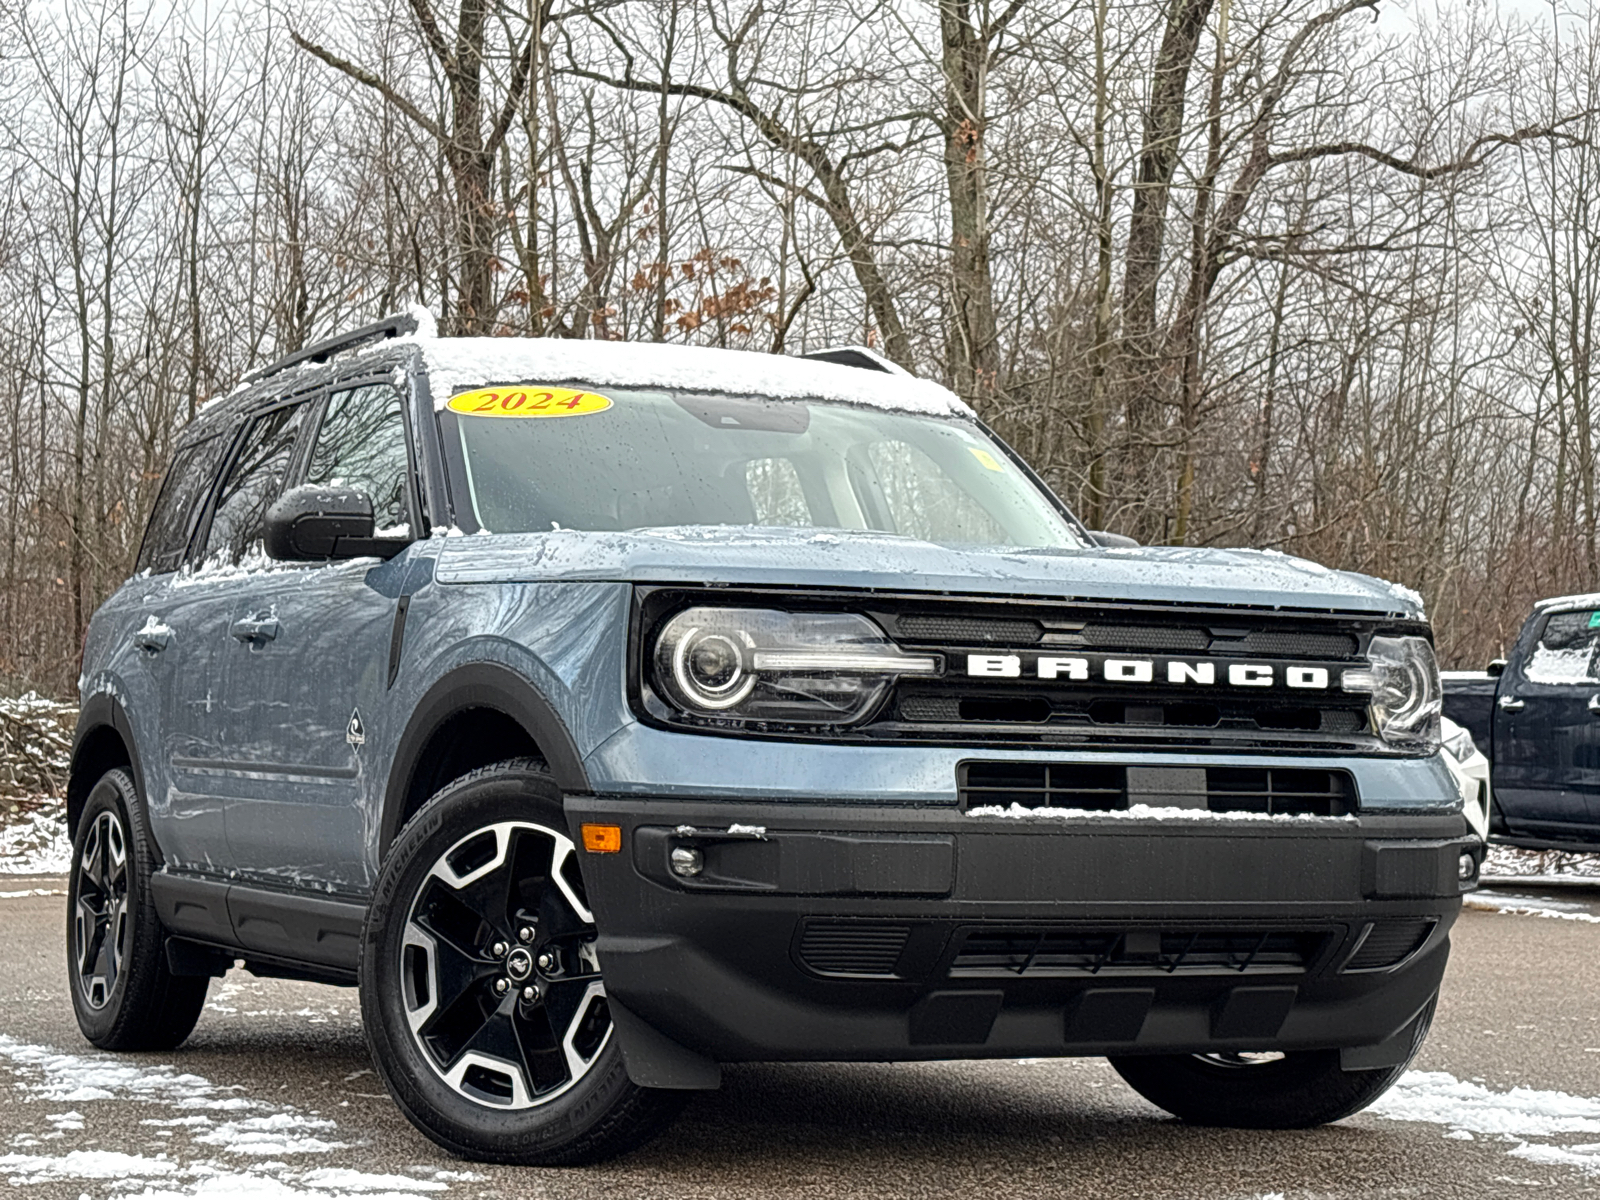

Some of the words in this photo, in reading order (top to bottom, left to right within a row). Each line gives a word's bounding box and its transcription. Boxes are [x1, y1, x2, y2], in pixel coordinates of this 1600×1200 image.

[472, 392, 585, 412] 2024
[967, 653, 1329, 689] BRONCO
[382, 813, 440, 899] MICHELIN
